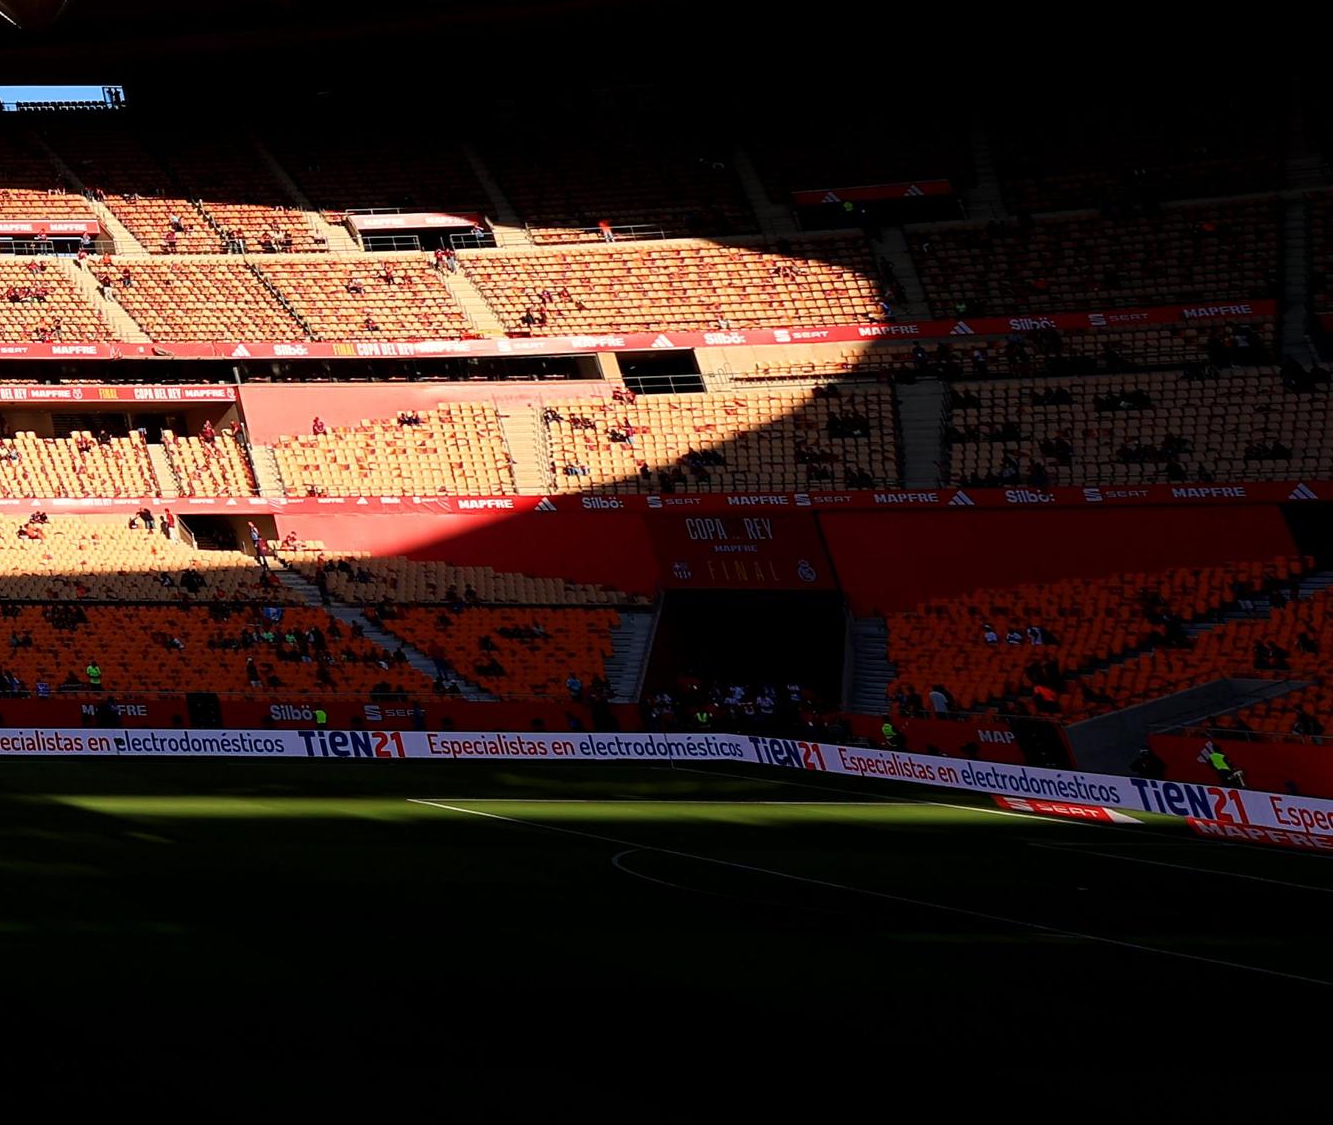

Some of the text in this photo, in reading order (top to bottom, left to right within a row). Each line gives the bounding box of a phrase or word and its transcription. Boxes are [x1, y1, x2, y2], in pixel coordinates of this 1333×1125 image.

[1183, 304, 1252, 319] MAPFRE
[859, 323, 919, 337] MAPFRE
[52, 345, 97, 355] MAPFRE
[333, 343, 355, 355] FINAL
[185, 389, 225, 398] MAPFRE
[874, 493, 938, 503] MAPFRE
[1005, 489, 1055, 503] Silbö:
[1105, 489, 1149, 499] SEAT
[1172, 486, 1245, 498] MAPFRE
[458, 499, 514, 509] MAPFRE
[583, 497, 624, 509] Silbö:
[727, 495, 789, 505] MAPFRE
[813, 495, 853, 503] SEAT
[685, 518, 773, 540] COPA REY
[81, 705, 147, 716] MFRE
[269, 705, 313, 721] Silbö
[88, 737, 111, 751] en
[115, 731, 285, 753] electrodomésticos
[977, 729, 1015, 743] MAP
[427, 733, 743, 759] Especialistas en electrodomésticos
[838, 747, 1120, 803] Especialistas en electrodomésticos
[1040, 806, 1099, 818] SEAT
